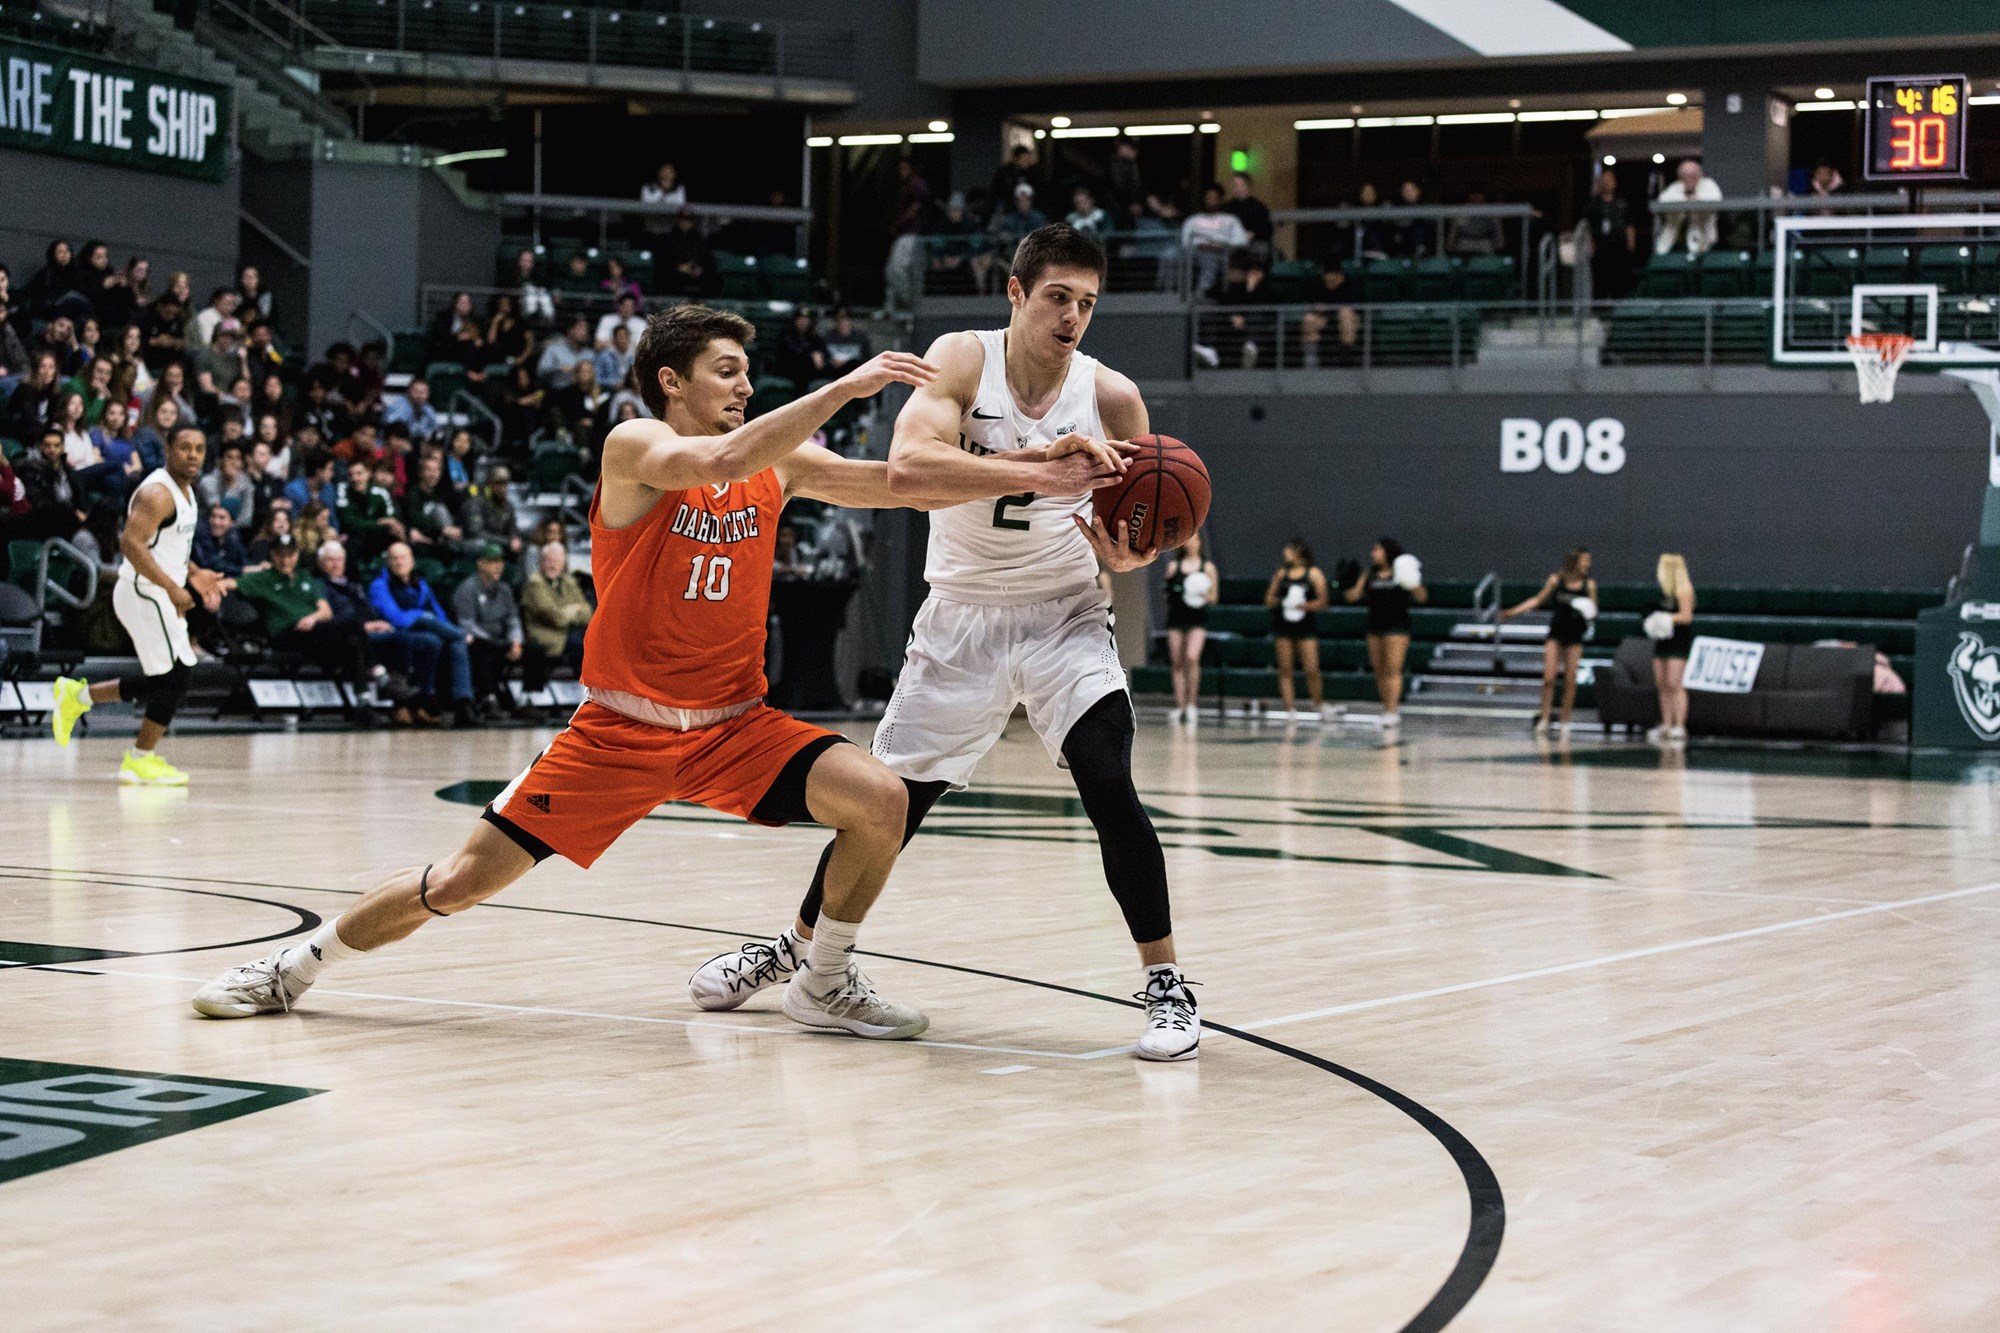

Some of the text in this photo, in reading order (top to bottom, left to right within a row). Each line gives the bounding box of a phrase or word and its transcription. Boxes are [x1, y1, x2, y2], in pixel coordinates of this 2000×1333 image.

[0, 57, 217, 162] RE THE SHIP
[1896, 85, 1957, 115] 4:16
[1889, 116, 1946, 168] 30
[1500, 417, 1627, 474] B08
[671, 503, 721, 544] DAHO
[993, 491, 1035, 531] 2
[683, 554, 733, 602] 10
[1689, 645, 1757, 688] NOISE
